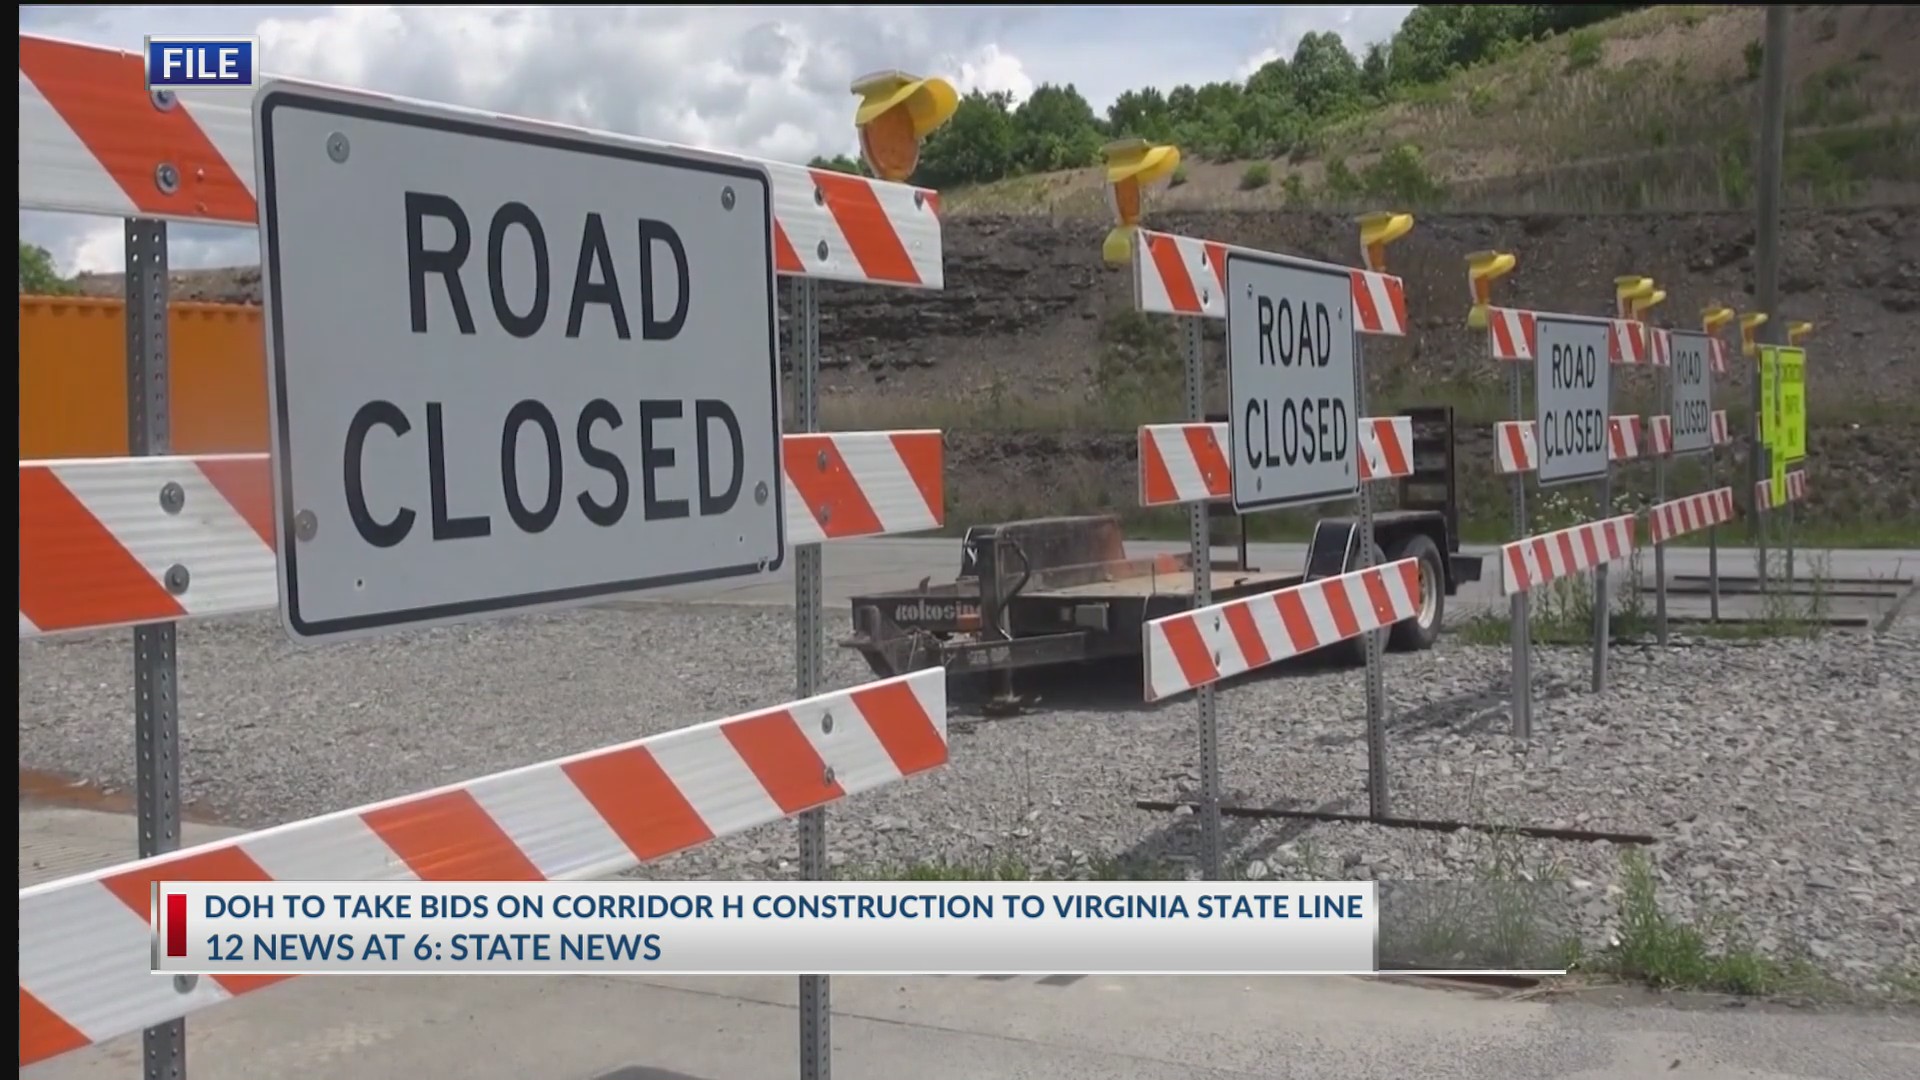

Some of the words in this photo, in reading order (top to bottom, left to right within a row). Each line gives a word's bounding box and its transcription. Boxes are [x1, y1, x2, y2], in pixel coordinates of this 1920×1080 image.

[404, 191, 690, 341] ROAD
[1257, 295, 1331, 368] ROAD
[1552, 343, 1596, 389] ROAD
[1676, 351, 1701, 385] ROAD
[1245, 397, 1348, 470] CLOSED
[1544, 408, 1604, 458] CLOSED
[1675, 400, 1708, 434] CLOSED
[343, 398, 745, 549] CLOSED
